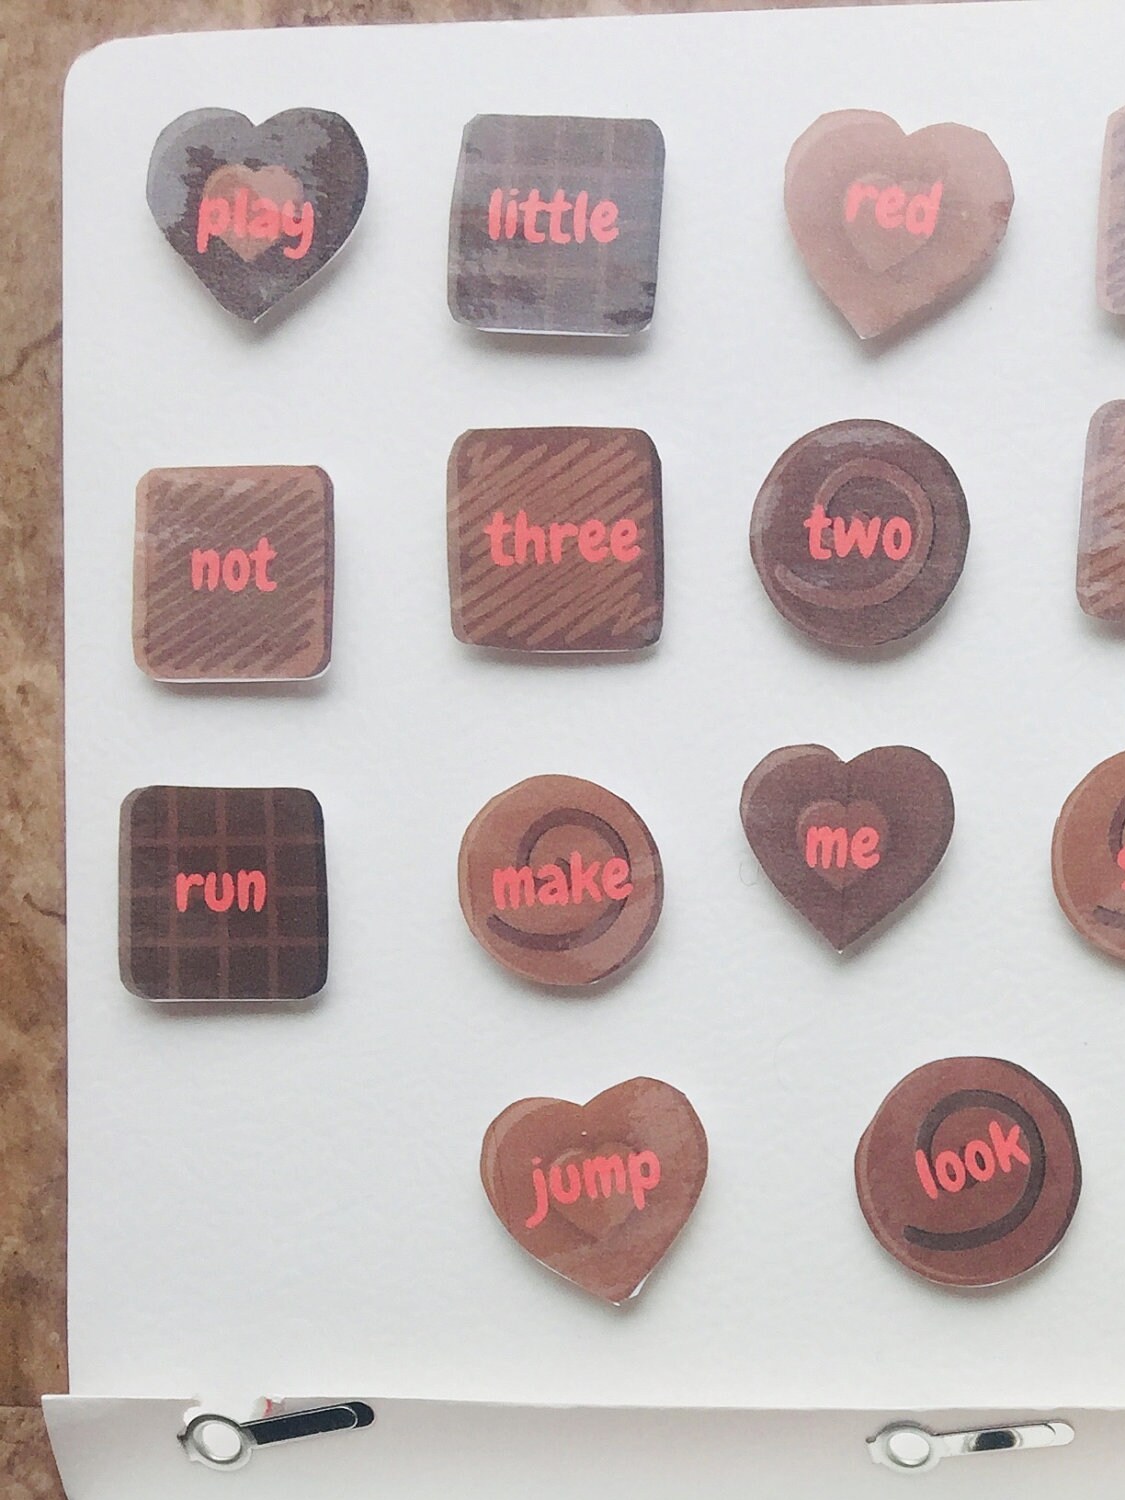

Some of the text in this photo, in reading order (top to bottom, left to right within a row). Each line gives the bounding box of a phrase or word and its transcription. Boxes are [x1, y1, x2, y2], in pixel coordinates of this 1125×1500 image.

[196, 186, 314, 259] play
[487, 189, 618, 244] little
[845, 182, 943, 236] red
[485, 511, 640, 566] three
[805, 504, 912, 560] two
[191, 537, 277, 592] not
[805, 825, 880, 869] me
[176, 870, 267, 912] run
[492, 852, 633, 909] make
[916, 1120, 1029, 1200] look
[526, 1150, 661, 1228] jump
